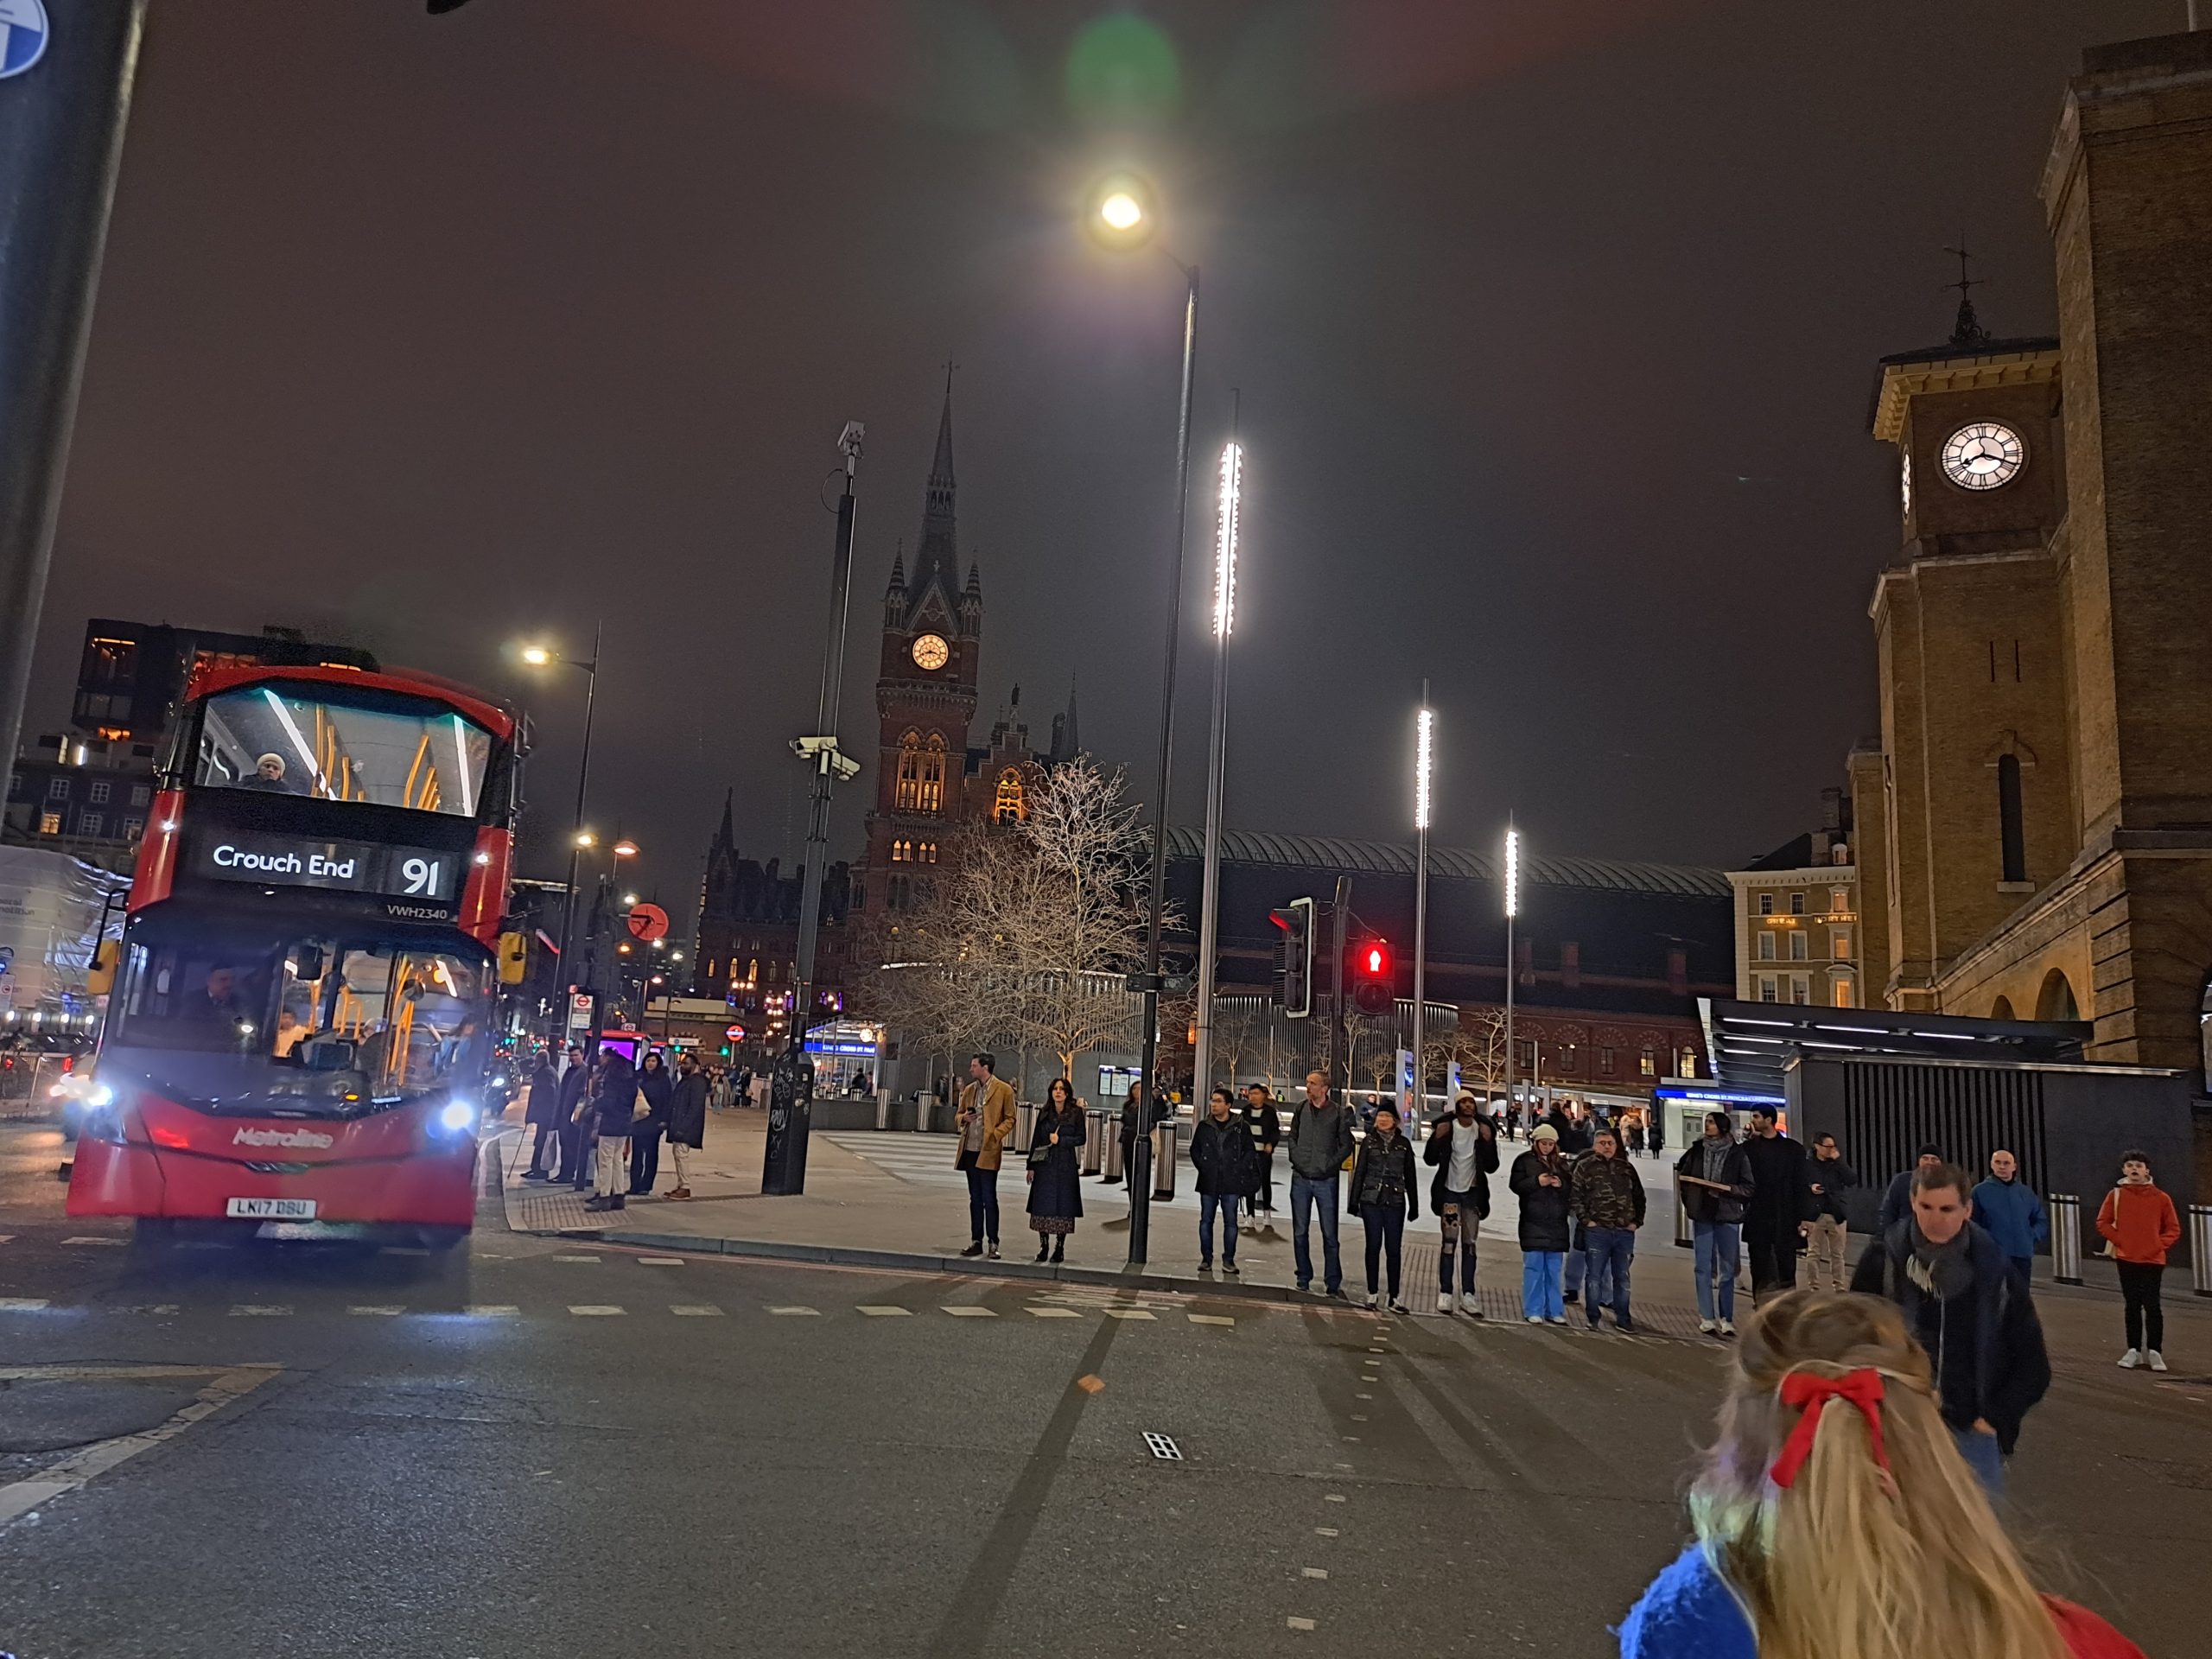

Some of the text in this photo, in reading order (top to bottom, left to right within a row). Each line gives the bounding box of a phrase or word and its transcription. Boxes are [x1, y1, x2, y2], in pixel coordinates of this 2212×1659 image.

[213, 845, 355, 879] Crouch End
[402, 858, 440, 896] 91
[387, 904, 448, 920] VWH2340
[232, 1126, 334, 1149] Metroline
[237, 1200, 272, 1215] LK17
